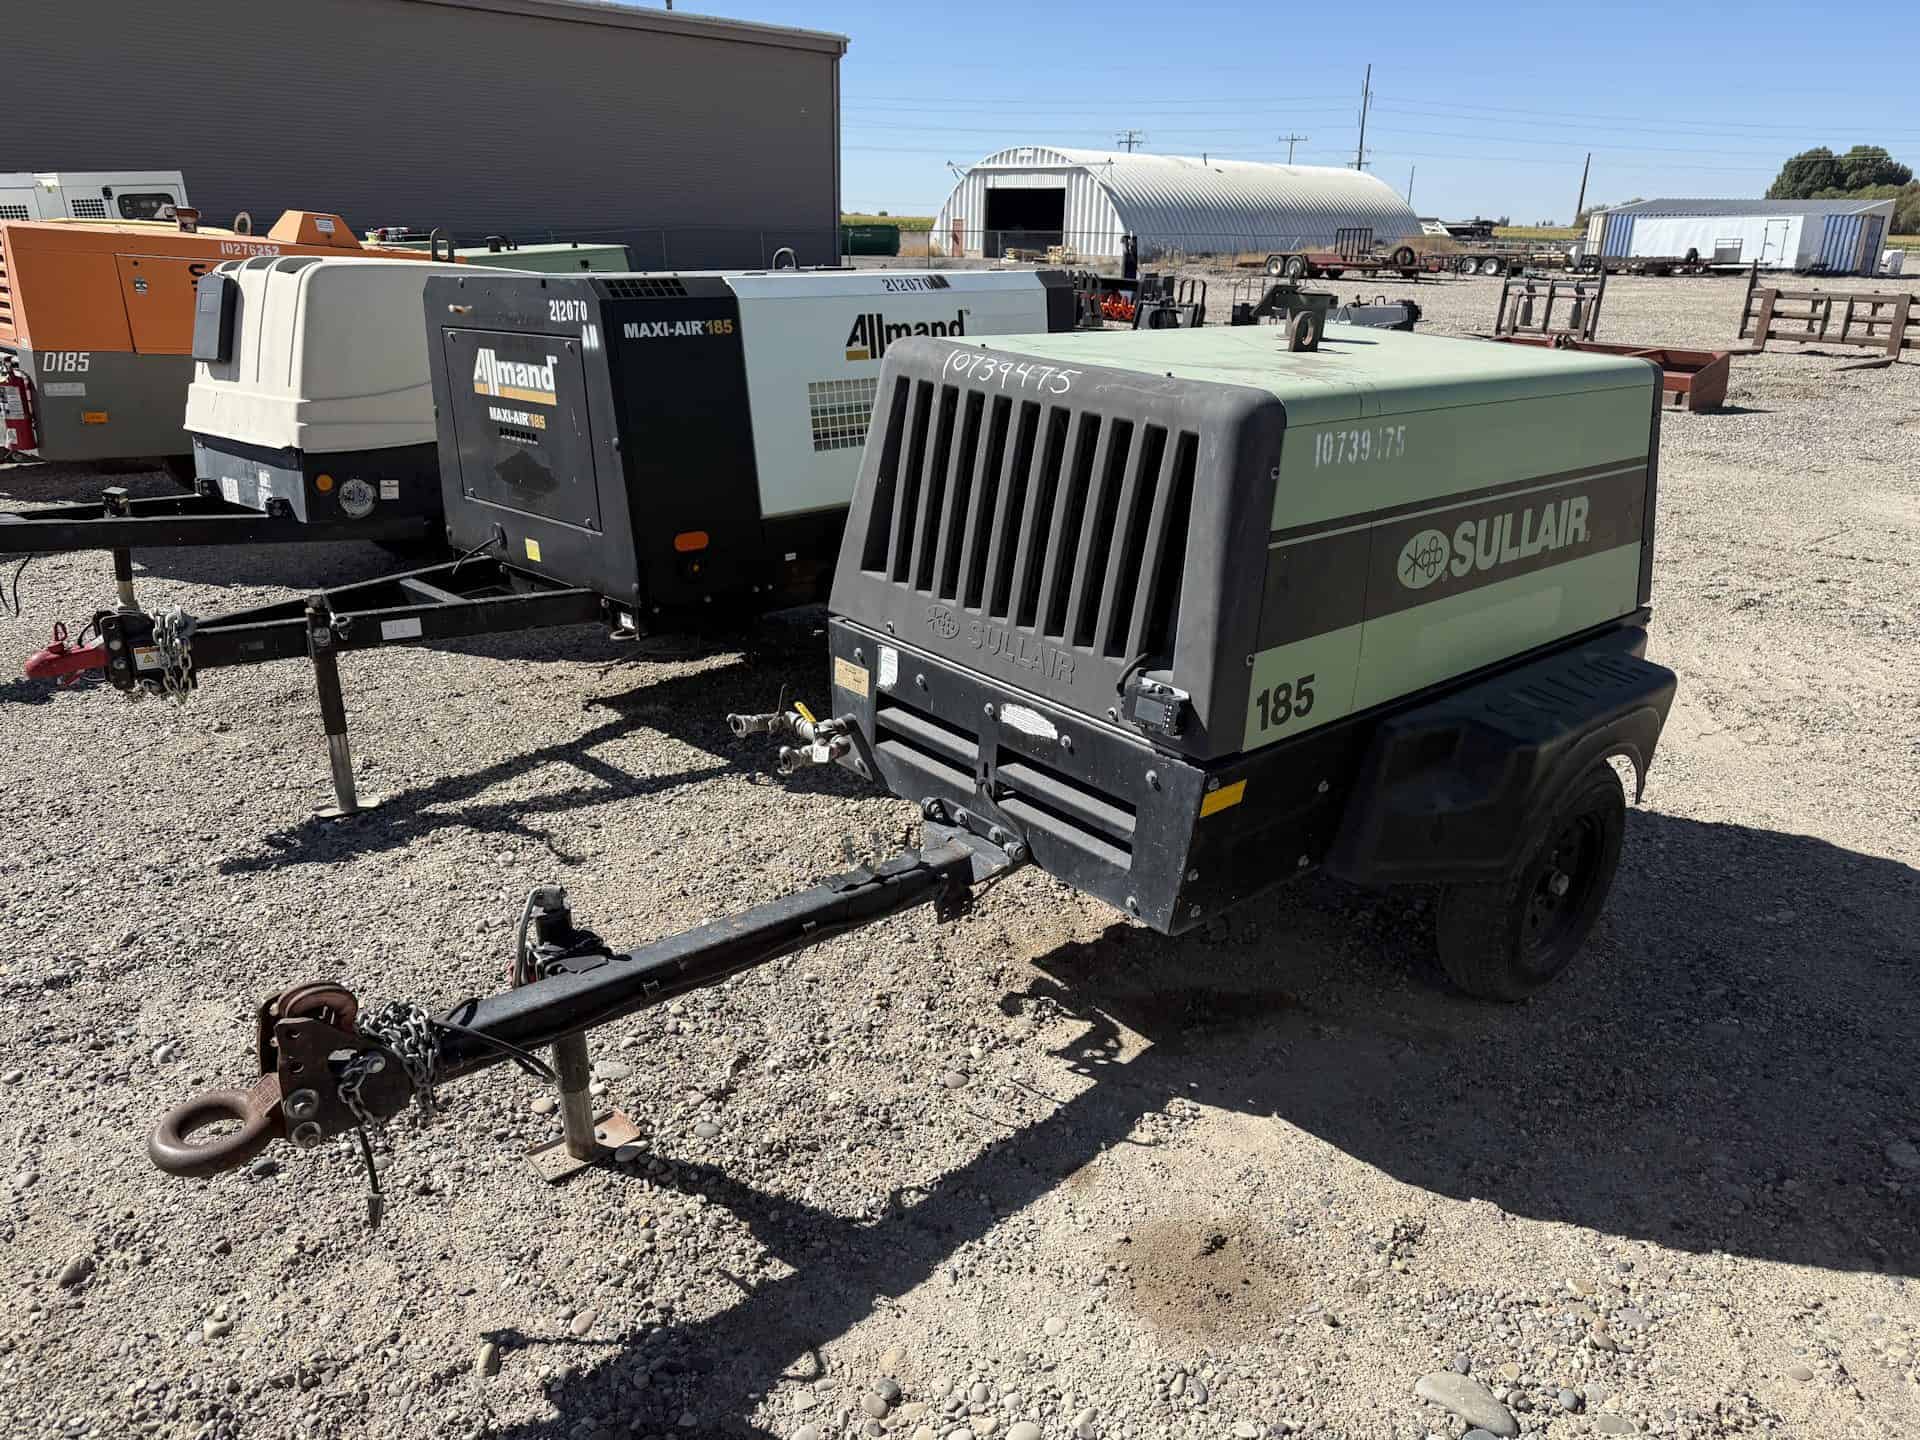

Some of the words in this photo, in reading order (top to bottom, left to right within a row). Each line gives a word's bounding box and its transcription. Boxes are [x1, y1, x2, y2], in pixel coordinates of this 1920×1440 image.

[548, 300, 588, 322] 212070
[623, 322, 704, 339] MAXI-AIR
[706, 319, 734, 336] 185
[42, 352, 91, 373] D185
[474, 347, 557, 395] Allmand
[942, 349, 1083, 394] 10739475
[488, 406, 529, 426] MAXI-AIR
[1450, 495, 1590, 578] SULLAIR
[967, 619, 1078, 686] SULLAIR
[1256, 673, 1316, 732] 185
